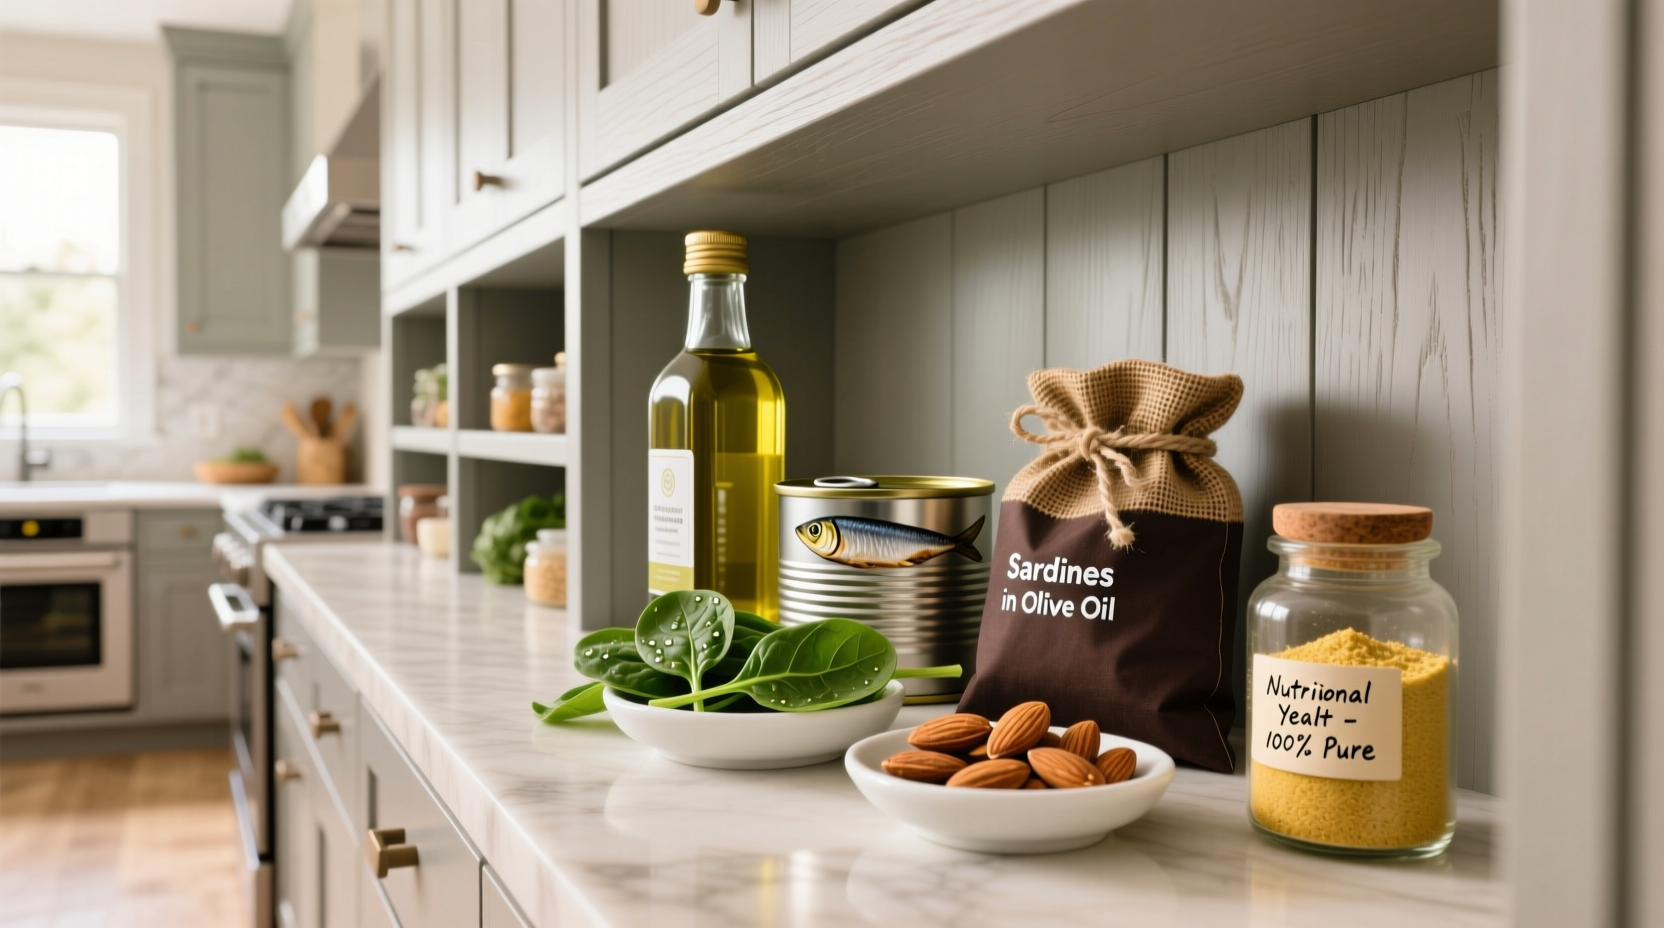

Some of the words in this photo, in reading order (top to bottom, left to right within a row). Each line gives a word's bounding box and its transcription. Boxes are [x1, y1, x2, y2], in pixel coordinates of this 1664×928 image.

[1007, 552, 1115, 588] Sardines
[1001, 587, 1017, 612] in
[1021, 590, 1075, 618] Olive
[1080, 595, 1116, 621] Oil
[1266, 674, 1372, 704] Nutriional
[1266, 731, 1312, 758] 100%
[1323, 735, 1376, 761] Pure
